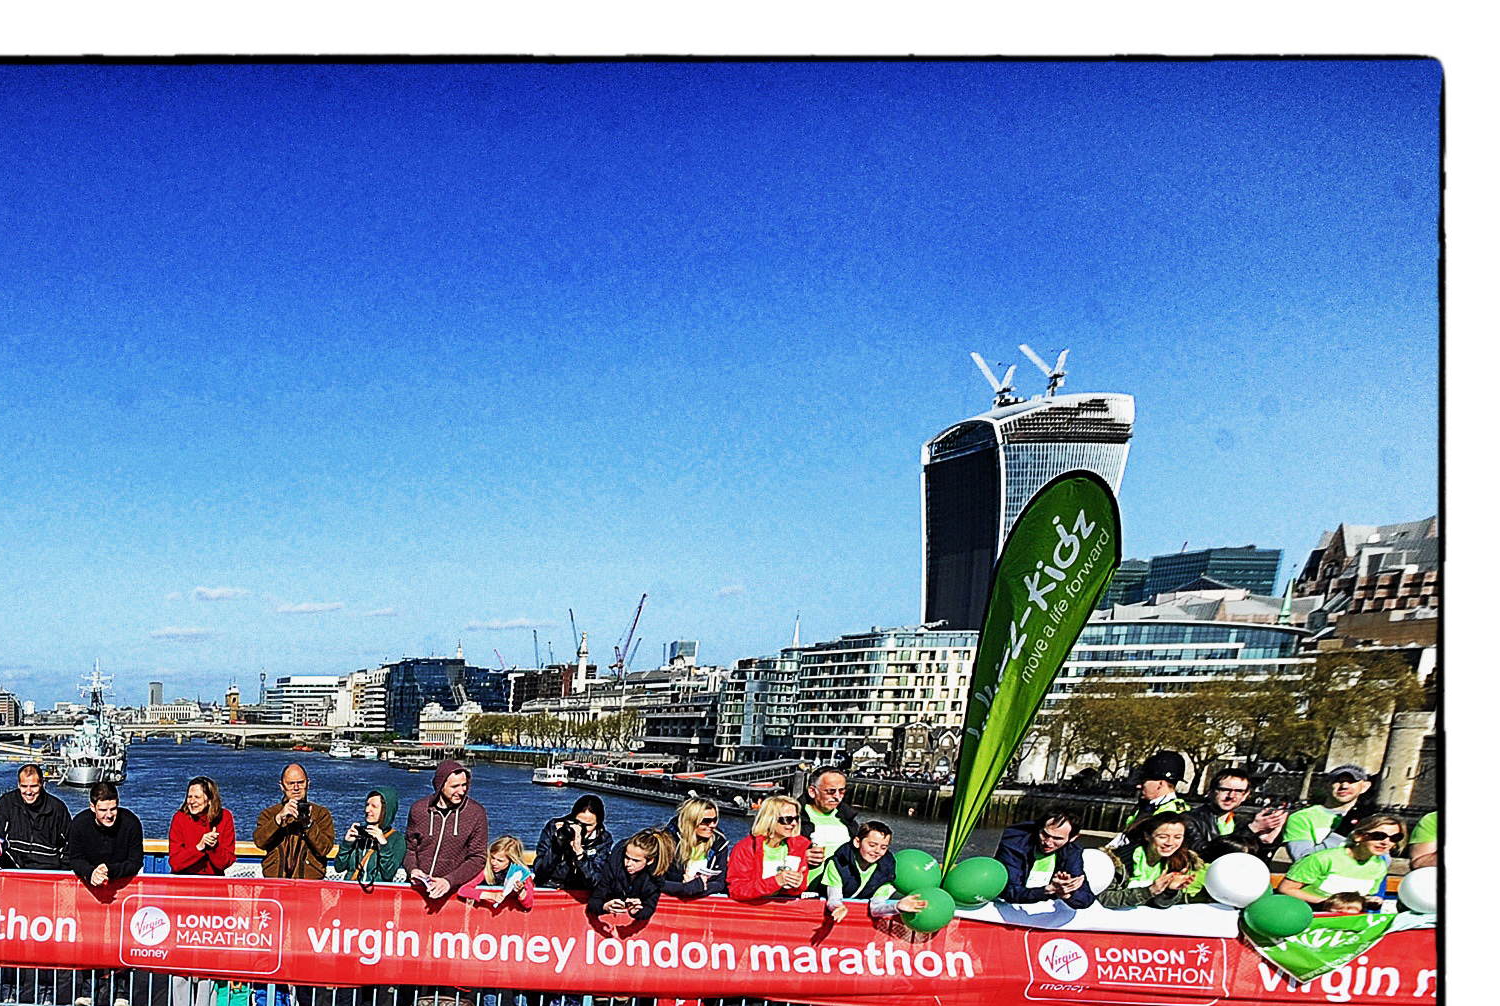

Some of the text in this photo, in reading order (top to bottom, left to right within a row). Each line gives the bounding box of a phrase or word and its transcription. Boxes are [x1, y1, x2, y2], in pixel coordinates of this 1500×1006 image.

[1020, 527, 1110, 684] move a life forward
[134, 912, 167, 939] Virgin
[176, 914, 250, 930] LONDON
[176, 930, 273, 947] MARATHON
[307, 919, 975, 979] virgin money london marathon
[130, 947, 168, 960] money
[1044, 945, 1083, 975] Virgin
[1094, 947, 1185, 965] LONDON
[1097, 964, 1214, 985] MARATHON
